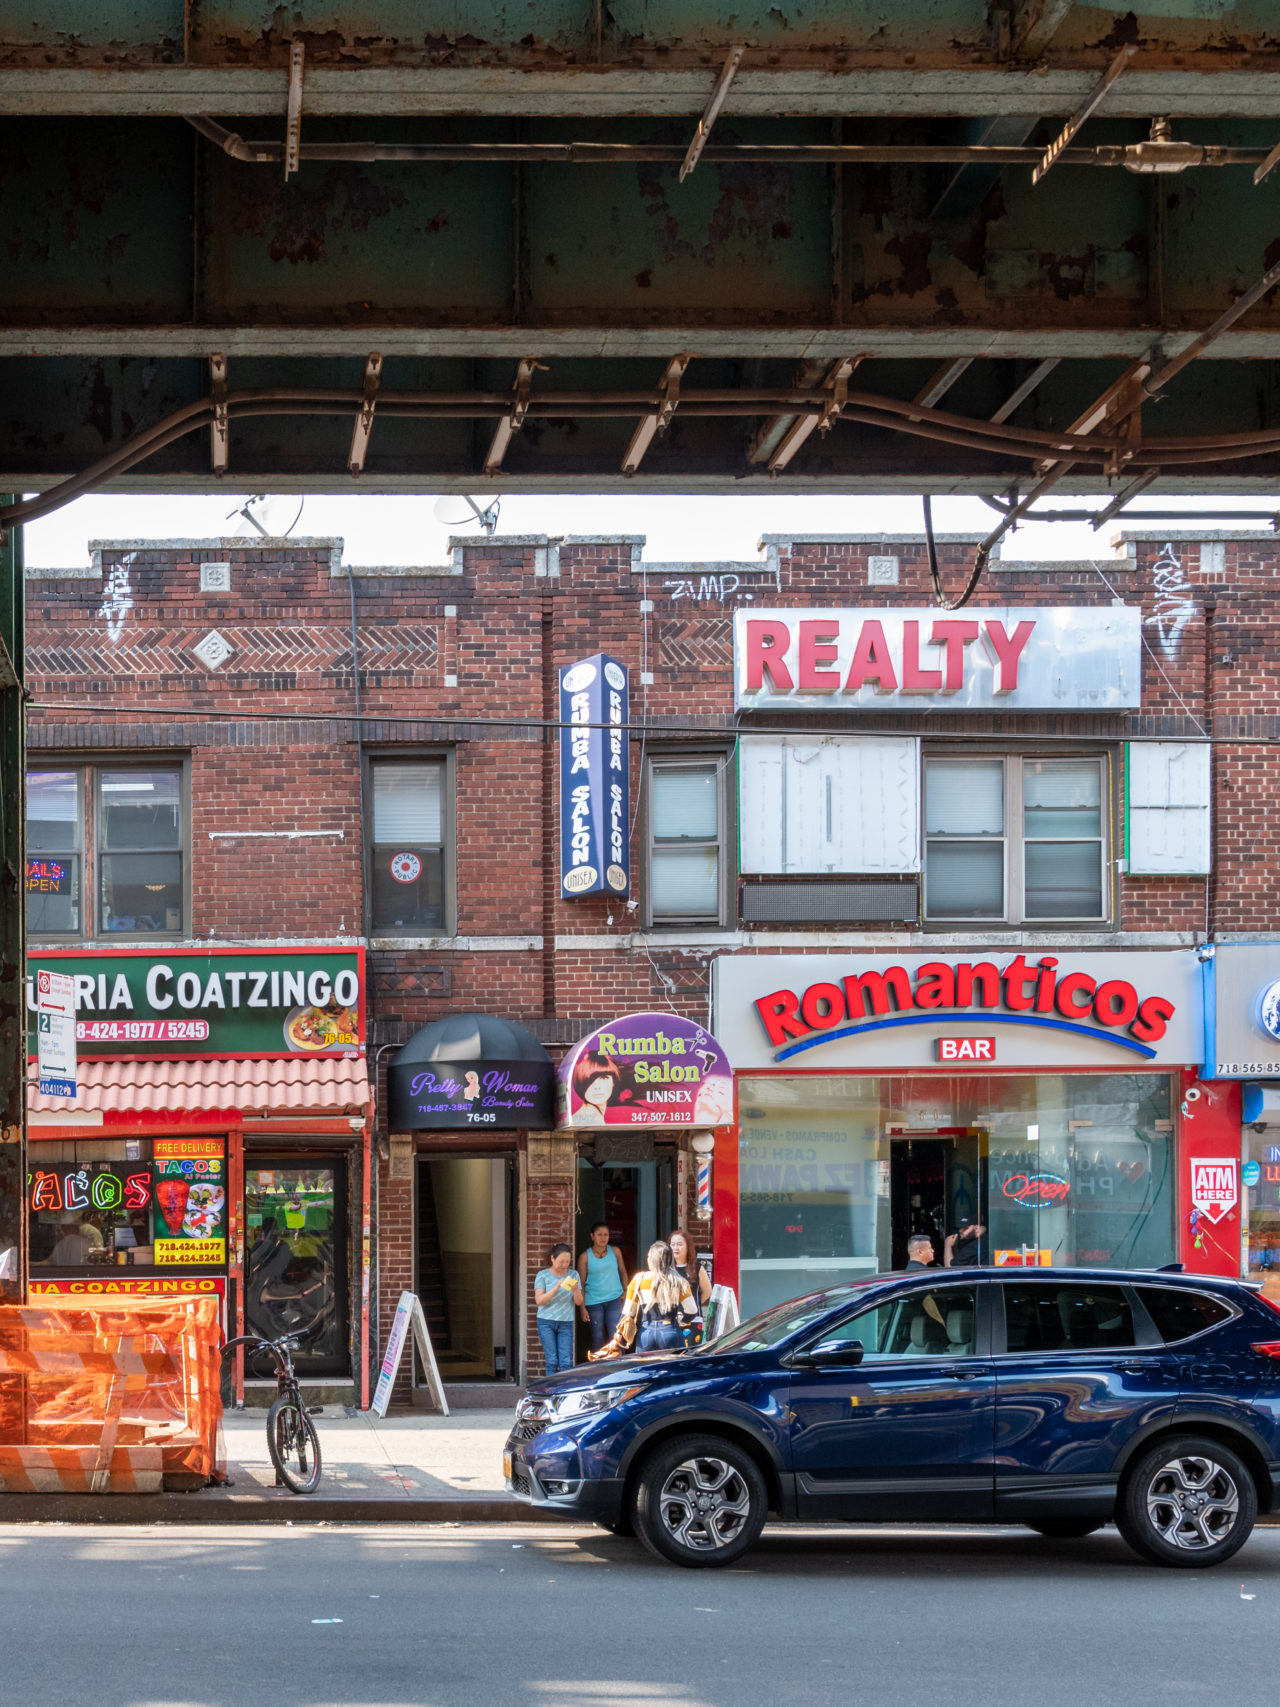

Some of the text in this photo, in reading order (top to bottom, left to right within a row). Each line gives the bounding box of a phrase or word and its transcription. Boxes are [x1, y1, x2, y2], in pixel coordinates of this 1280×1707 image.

[744, 619, 1037, 696] REALTY
[570, 692, 590, 775] RUMBA
[610, 690, 622, 864] RUMBA SALON
[571, 785, 591, 866] SALON
[394, 854, 418, 866] NOTARY
[394, 869, 418, 880] PUBLIC
[567, 870, 594, 889] UNISEX
[26, 879, 60, 892] PEN
[146, 964, 359, 1011] COATZINGO
[755, 955, 1176, 1048] Romanticos
[41, 1014, 49, 1031] 2
[76, 1022, 156, 1040] 8-424-1977
[168, 1022, 205, 1040] 5245
[323, 1033, 352, 1044] 76-05
[598, 1032, 686, 1056] Rumba
[941, 1039, 992, 1060] BAR
[634, 1061, 700, 1084] Salon
[410, 1070, 539, 1099] Pretty Woman
[481, 1095, 514, 1109] Beauty
[646, 1090, 692, 1104] UNISEX
[467, 1113, 496, 1122] 76-05
[631, 1112, 691, 1122] 347-507-1612
[157, 1143, 222, 1153] FREE DELIVERY
[156, 1160, 221, 1173] TACOS
[1196, 1167, 1233, 1189] ATM
[28, 1171, 151, 1210] ACOS
[1003, 1174, 1071, 1200] Open
[1197, 1190, 1233, 1200] HERE
[159, 1243, 221, 1251] 718.424.1977
[159, 1254, 221, 1262] 718.424.5245
[70, 1280, 216, 1294] COATZINGO
